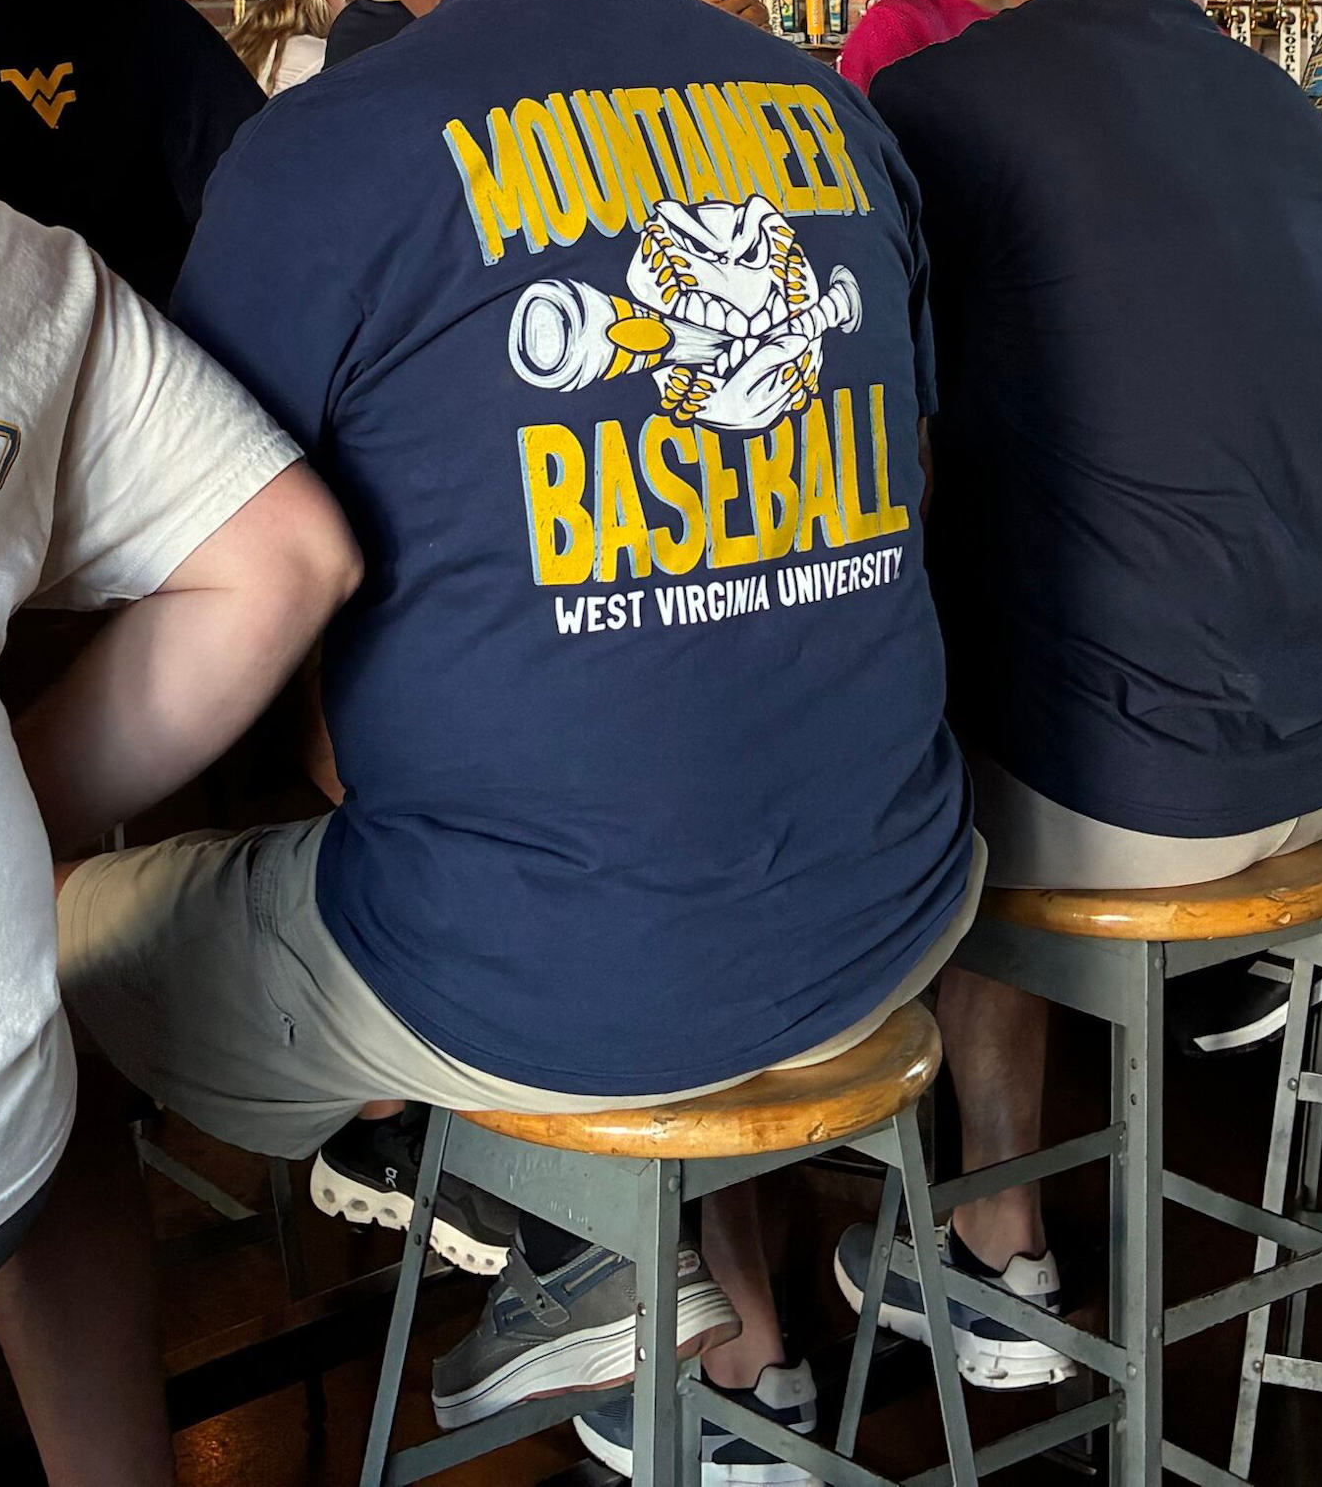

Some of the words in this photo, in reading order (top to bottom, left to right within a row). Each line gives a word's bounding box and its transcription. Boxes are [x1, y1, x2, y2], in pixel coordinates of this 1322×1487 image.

[1284, 26, 1297, 73] LOCAL
[443, 82, 873, 266] MOUNTAINEER
[517, 383, 910, 586] BASEBALL
[554, 589, 645, 635] WEST
[655, 575, 770, 626] VIRGINIA
[777, 545, 904, 607] UNIVERSITY
